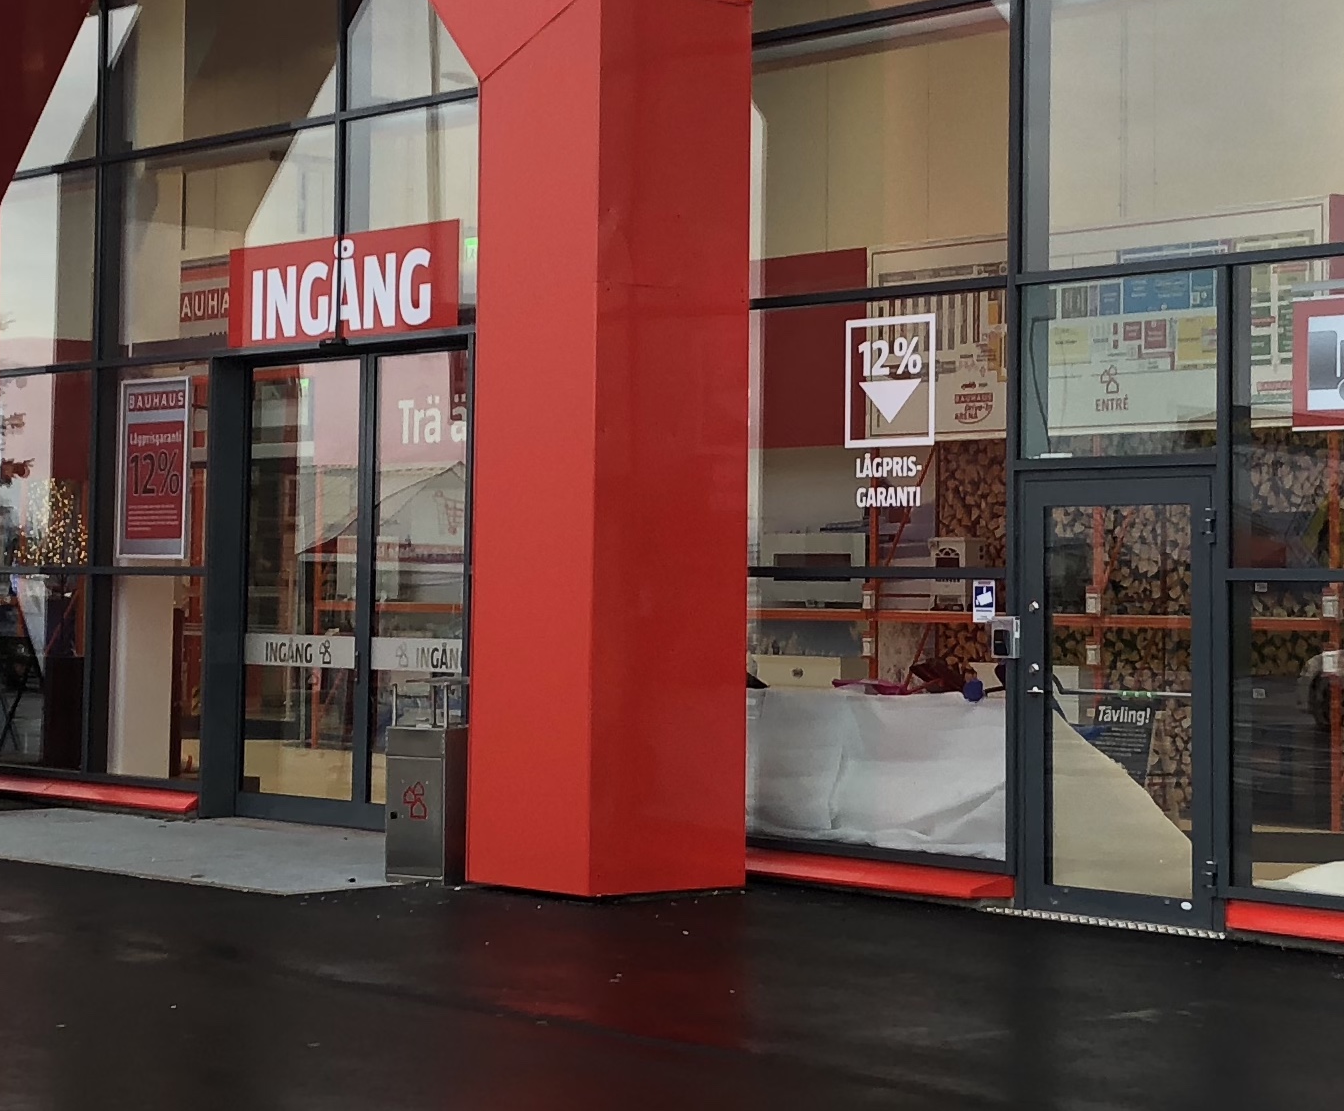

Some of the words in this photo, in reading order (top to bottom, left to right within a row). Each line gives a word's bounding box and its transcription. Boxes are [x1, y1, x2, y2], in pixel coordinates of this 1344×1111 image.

[251, 239, 432, 341] INGÅNG
[181, 291, 229, 320] AUHA
[858, 336, 923, 377] 12%
[129, 391, 184, 410] BAUHAUS
[1095, 394, 1129, 412] ENTRÉ
[398, 394, 441, 444] Trä
[130, 449, 181, 496] 12%
[856, 453, 922, 478] LÅGPRIS-
[856, 487, 921, 508] GARANTI
[264, 637, 314, 665] INGÅNG
[416, 641, 460, 670] INGÅN
[1098, 705, 1151, 726] Tävling!
